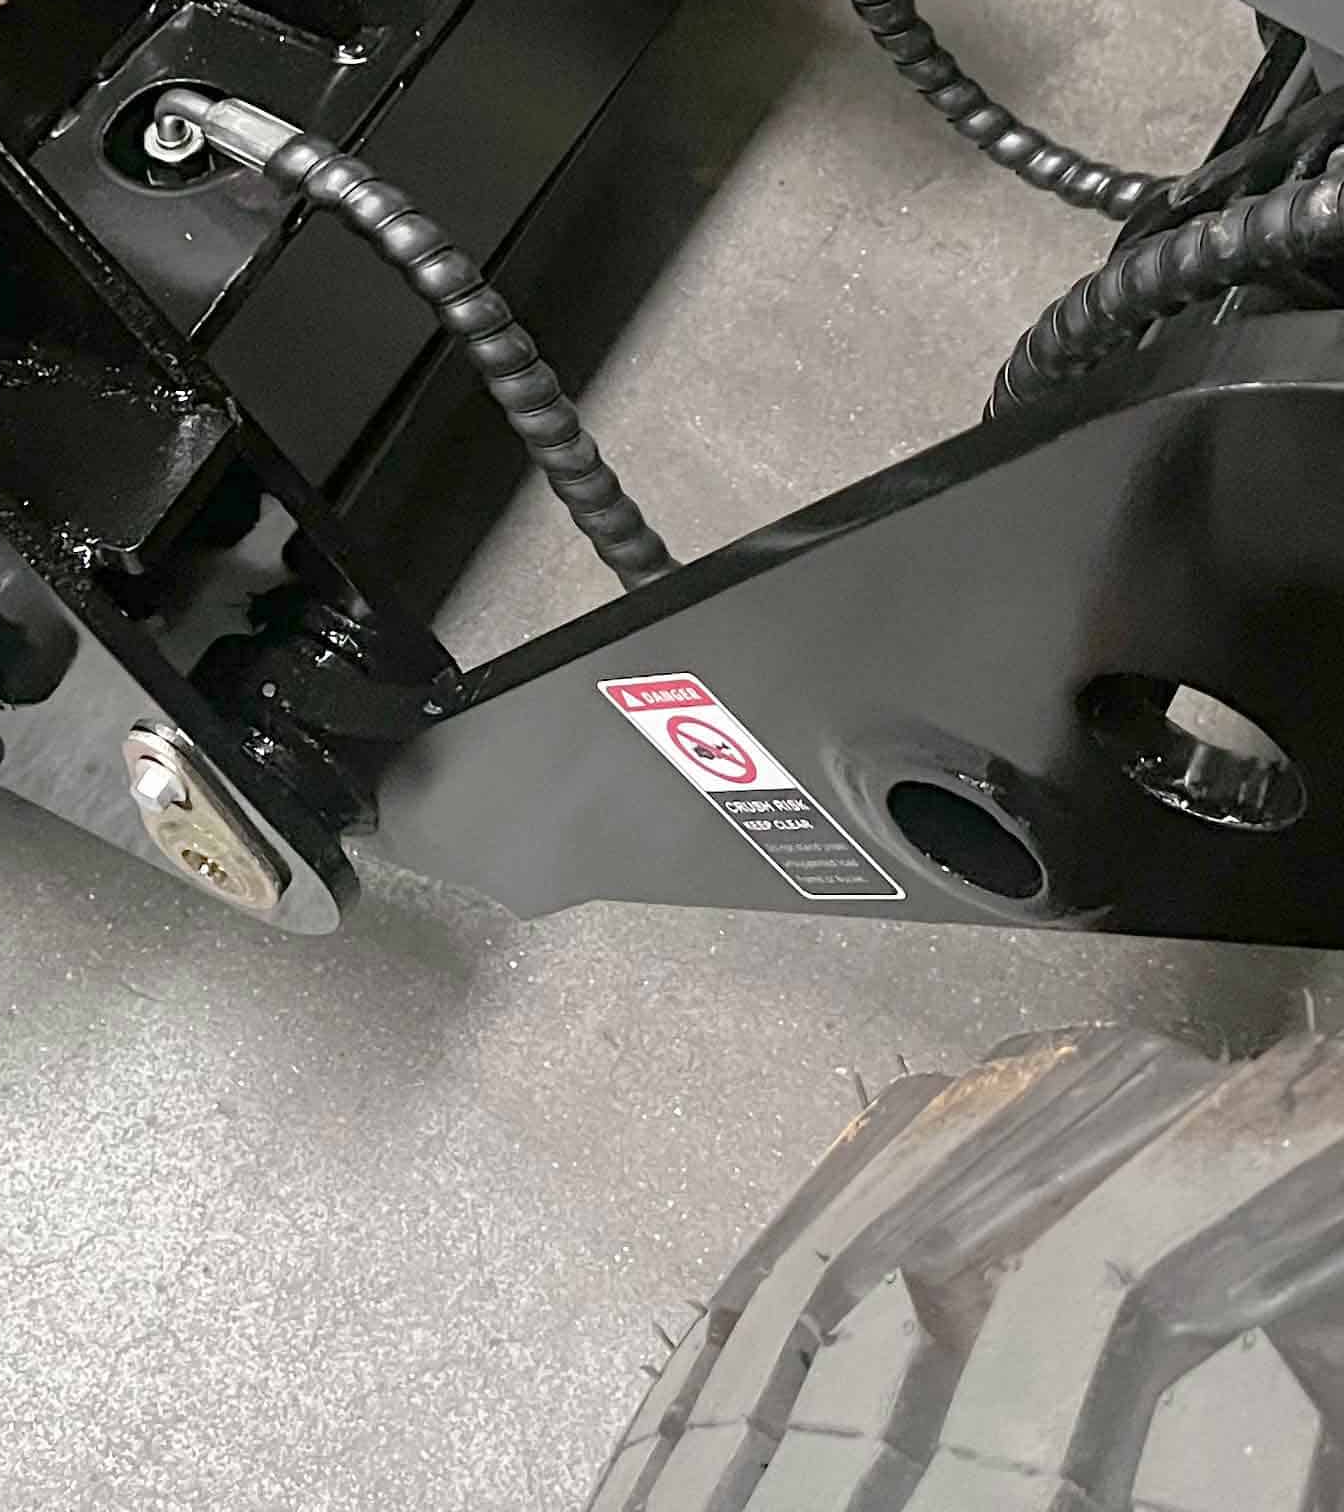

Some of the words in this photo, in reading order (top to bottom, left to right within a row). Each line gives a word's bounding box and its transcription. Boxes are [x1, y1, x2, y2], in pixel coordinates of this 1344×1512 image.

[640, 687, 703, 705] DANGER
[725, 800, 775, 814] CRUSH
[742, 819, 772, 831] KEEP
[772, 819, 815, 831] CLEAR
